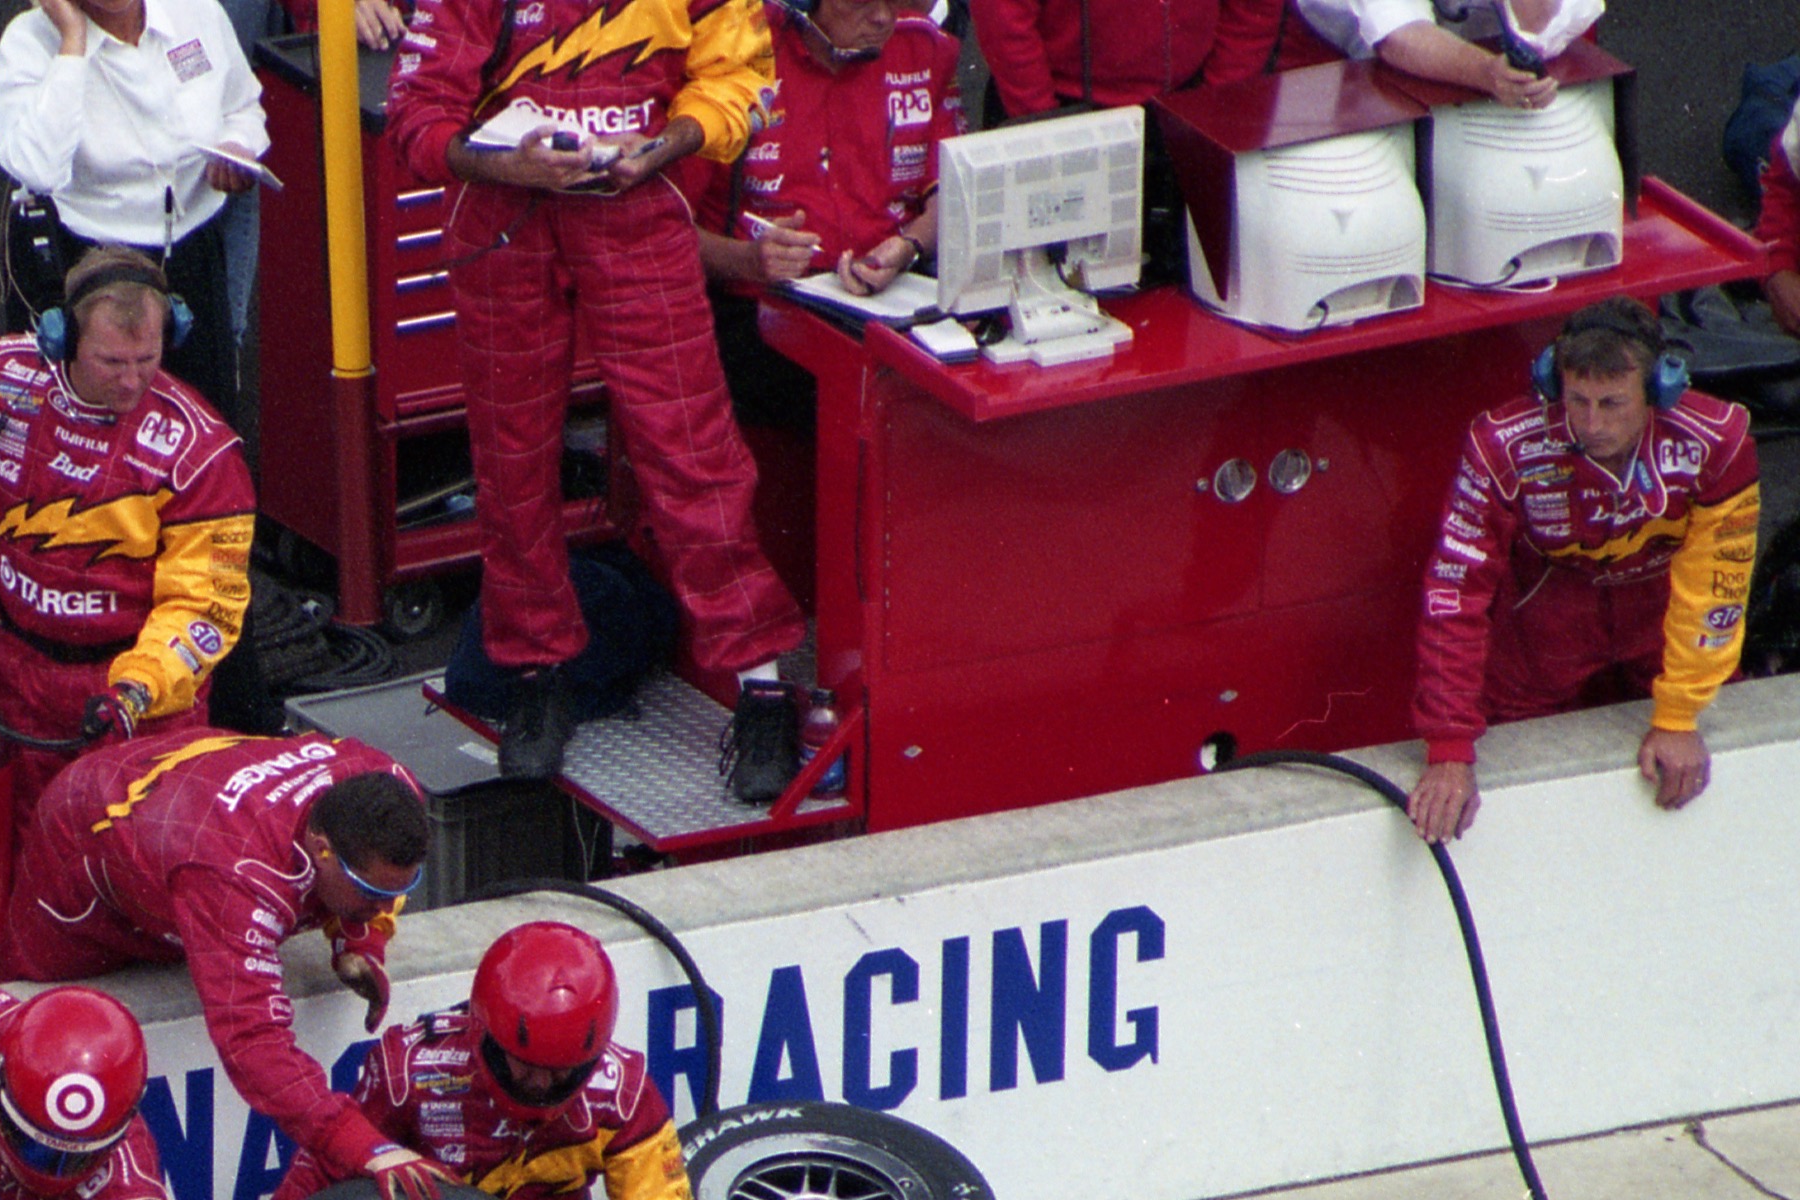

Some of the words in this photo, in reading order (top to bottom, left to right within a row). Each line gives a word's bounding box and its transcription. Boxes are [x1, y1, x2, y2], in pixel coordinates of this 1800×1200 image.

[885, 69, 932, 85] FUJIFILM
[546, 99, 656, 135] TARGET
[889, 90, 932, 121] PPG
[746, 174, 785, 192] Bud
[54, 425, 109, 453] FUJIFILM
[139, 411, 182, 450] PPG
[48, 451, 101, 482] Bud
[1661, 440, 1701, 469] PPG
[1712, 570, 1746, 585] DOG
[16, 571, 119, 616] TARGET
[1707, 605, 1743, 628] STP
[189, 621, 223, 655] STP
[646, 904, 1167, 1121] RACING
[415, 1047, 471, 1063] Energizer
